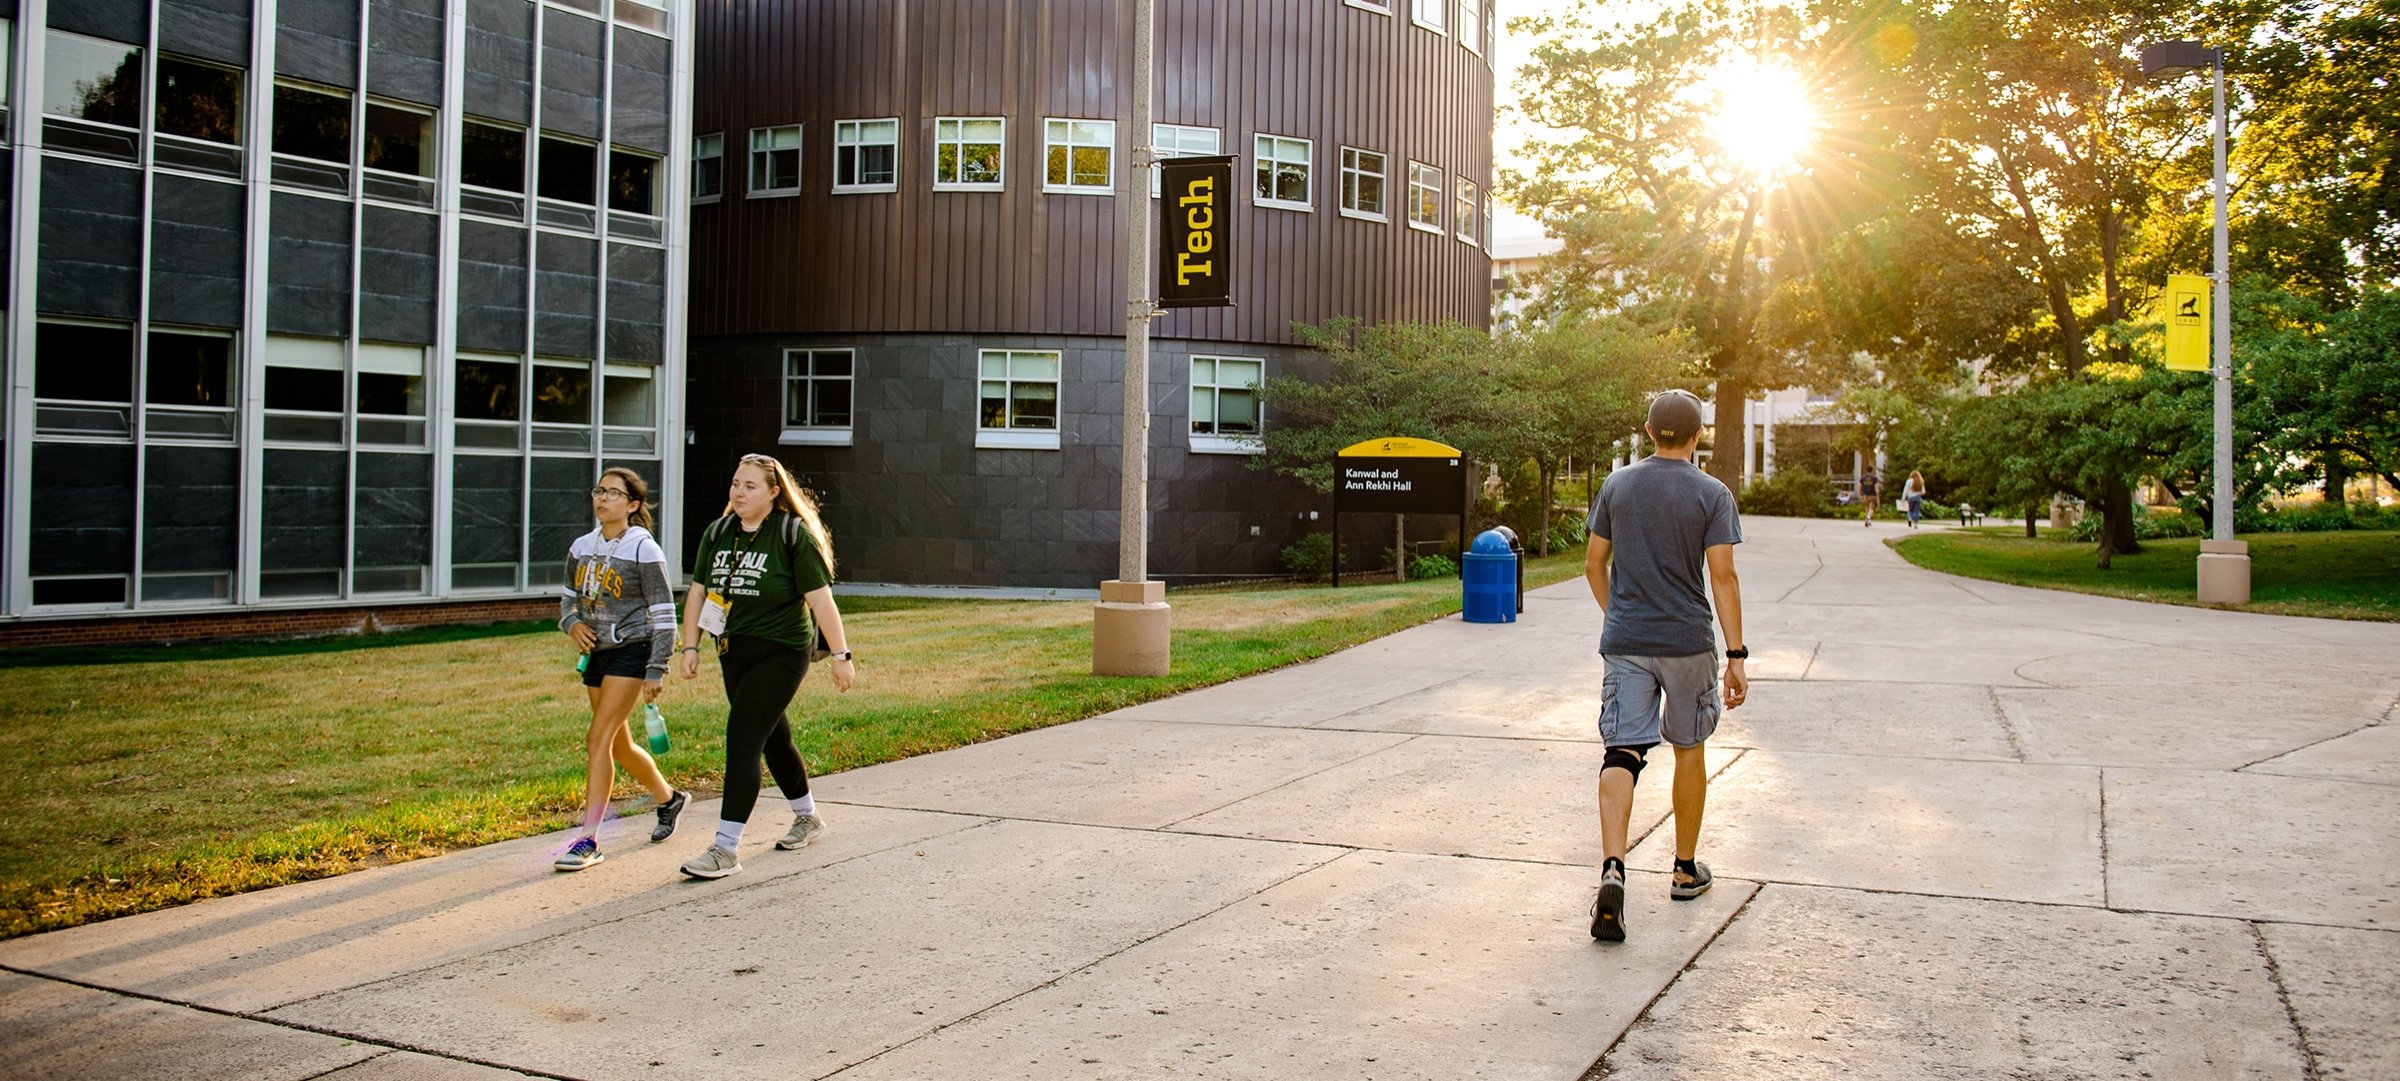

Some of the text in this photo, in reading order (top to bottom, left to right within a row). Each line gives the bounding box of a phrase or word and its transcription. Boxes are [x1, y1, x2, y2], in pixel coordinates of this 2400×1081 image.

[1178, 176, 1213, 286] Tech
[1345, 468, 1399, 479] Kanwal and
[1345, 480, 1411, 491] Ann Rekhi Hall
[712, 550, 731, 568] ST.
